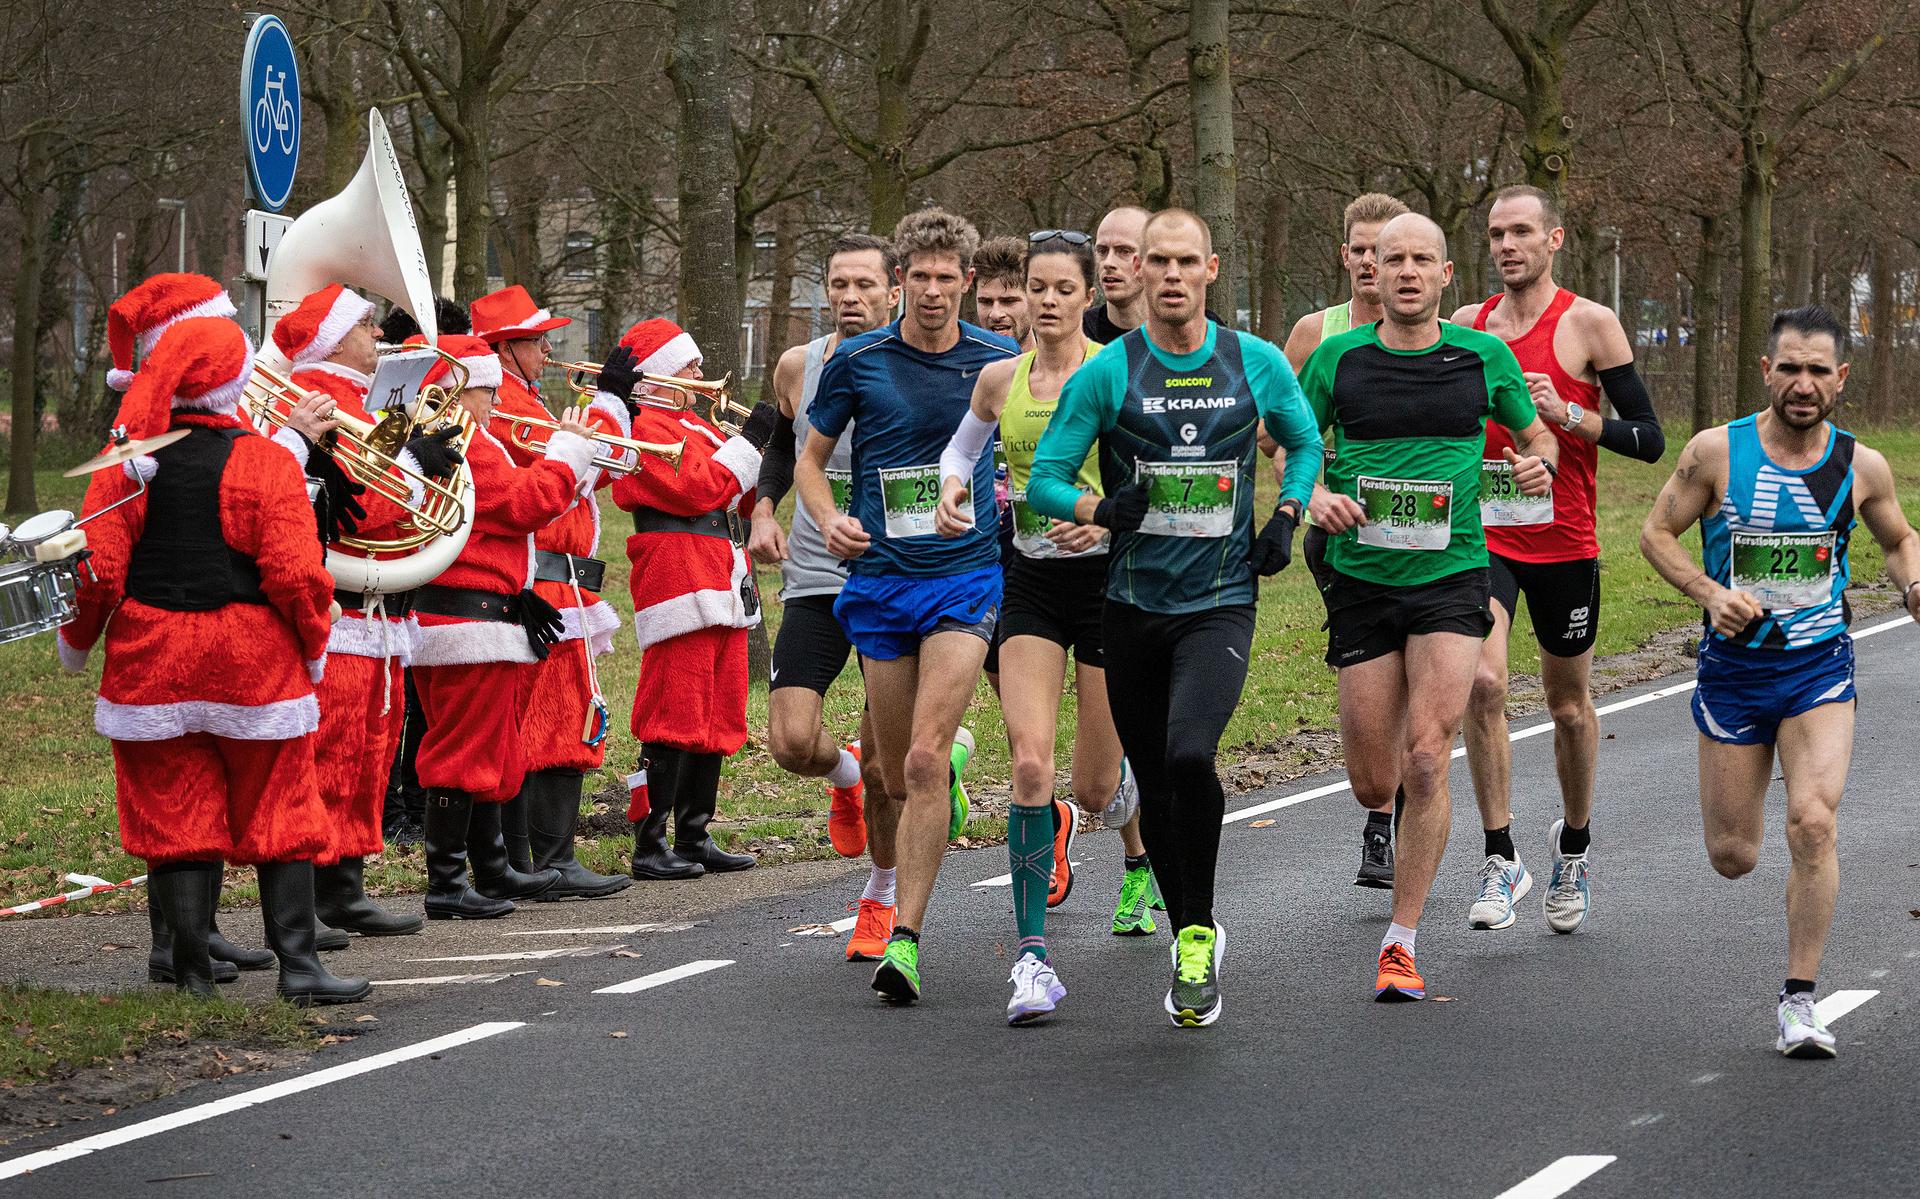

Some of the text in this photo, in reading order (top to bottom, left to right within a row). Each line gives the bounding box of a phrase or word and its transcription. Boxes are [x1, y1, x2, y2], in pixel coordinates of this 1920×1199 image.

[1165, 377, 1213, 388] saucony
[1167, 397, 1236, 410] KRAMP
[1002, 435, 1037, 452] Victo
[882, 469, 922, 481] Kerstloop
[1140, 464, 1184, 477] Kerstloop
[1185, 465, 1222, 476] Dronten
[914, 478, 940, 503] 29
[1180, 477, 1194, 503] 7
[1361, 479, 1401, 492] Kerstloop
[1403, 482, 1439, 492] Dronten
[1160, 503, 1215, 515] Gert-Jan
[1390, 493, 1417, 518] 28
[1391, 518, 1415, 528] Dirk
[1735, 534, 1780, 548] Kerstloop
[1782, 536, 1822, 546] Dronten
[1770, 548, 1799, 574] 22
